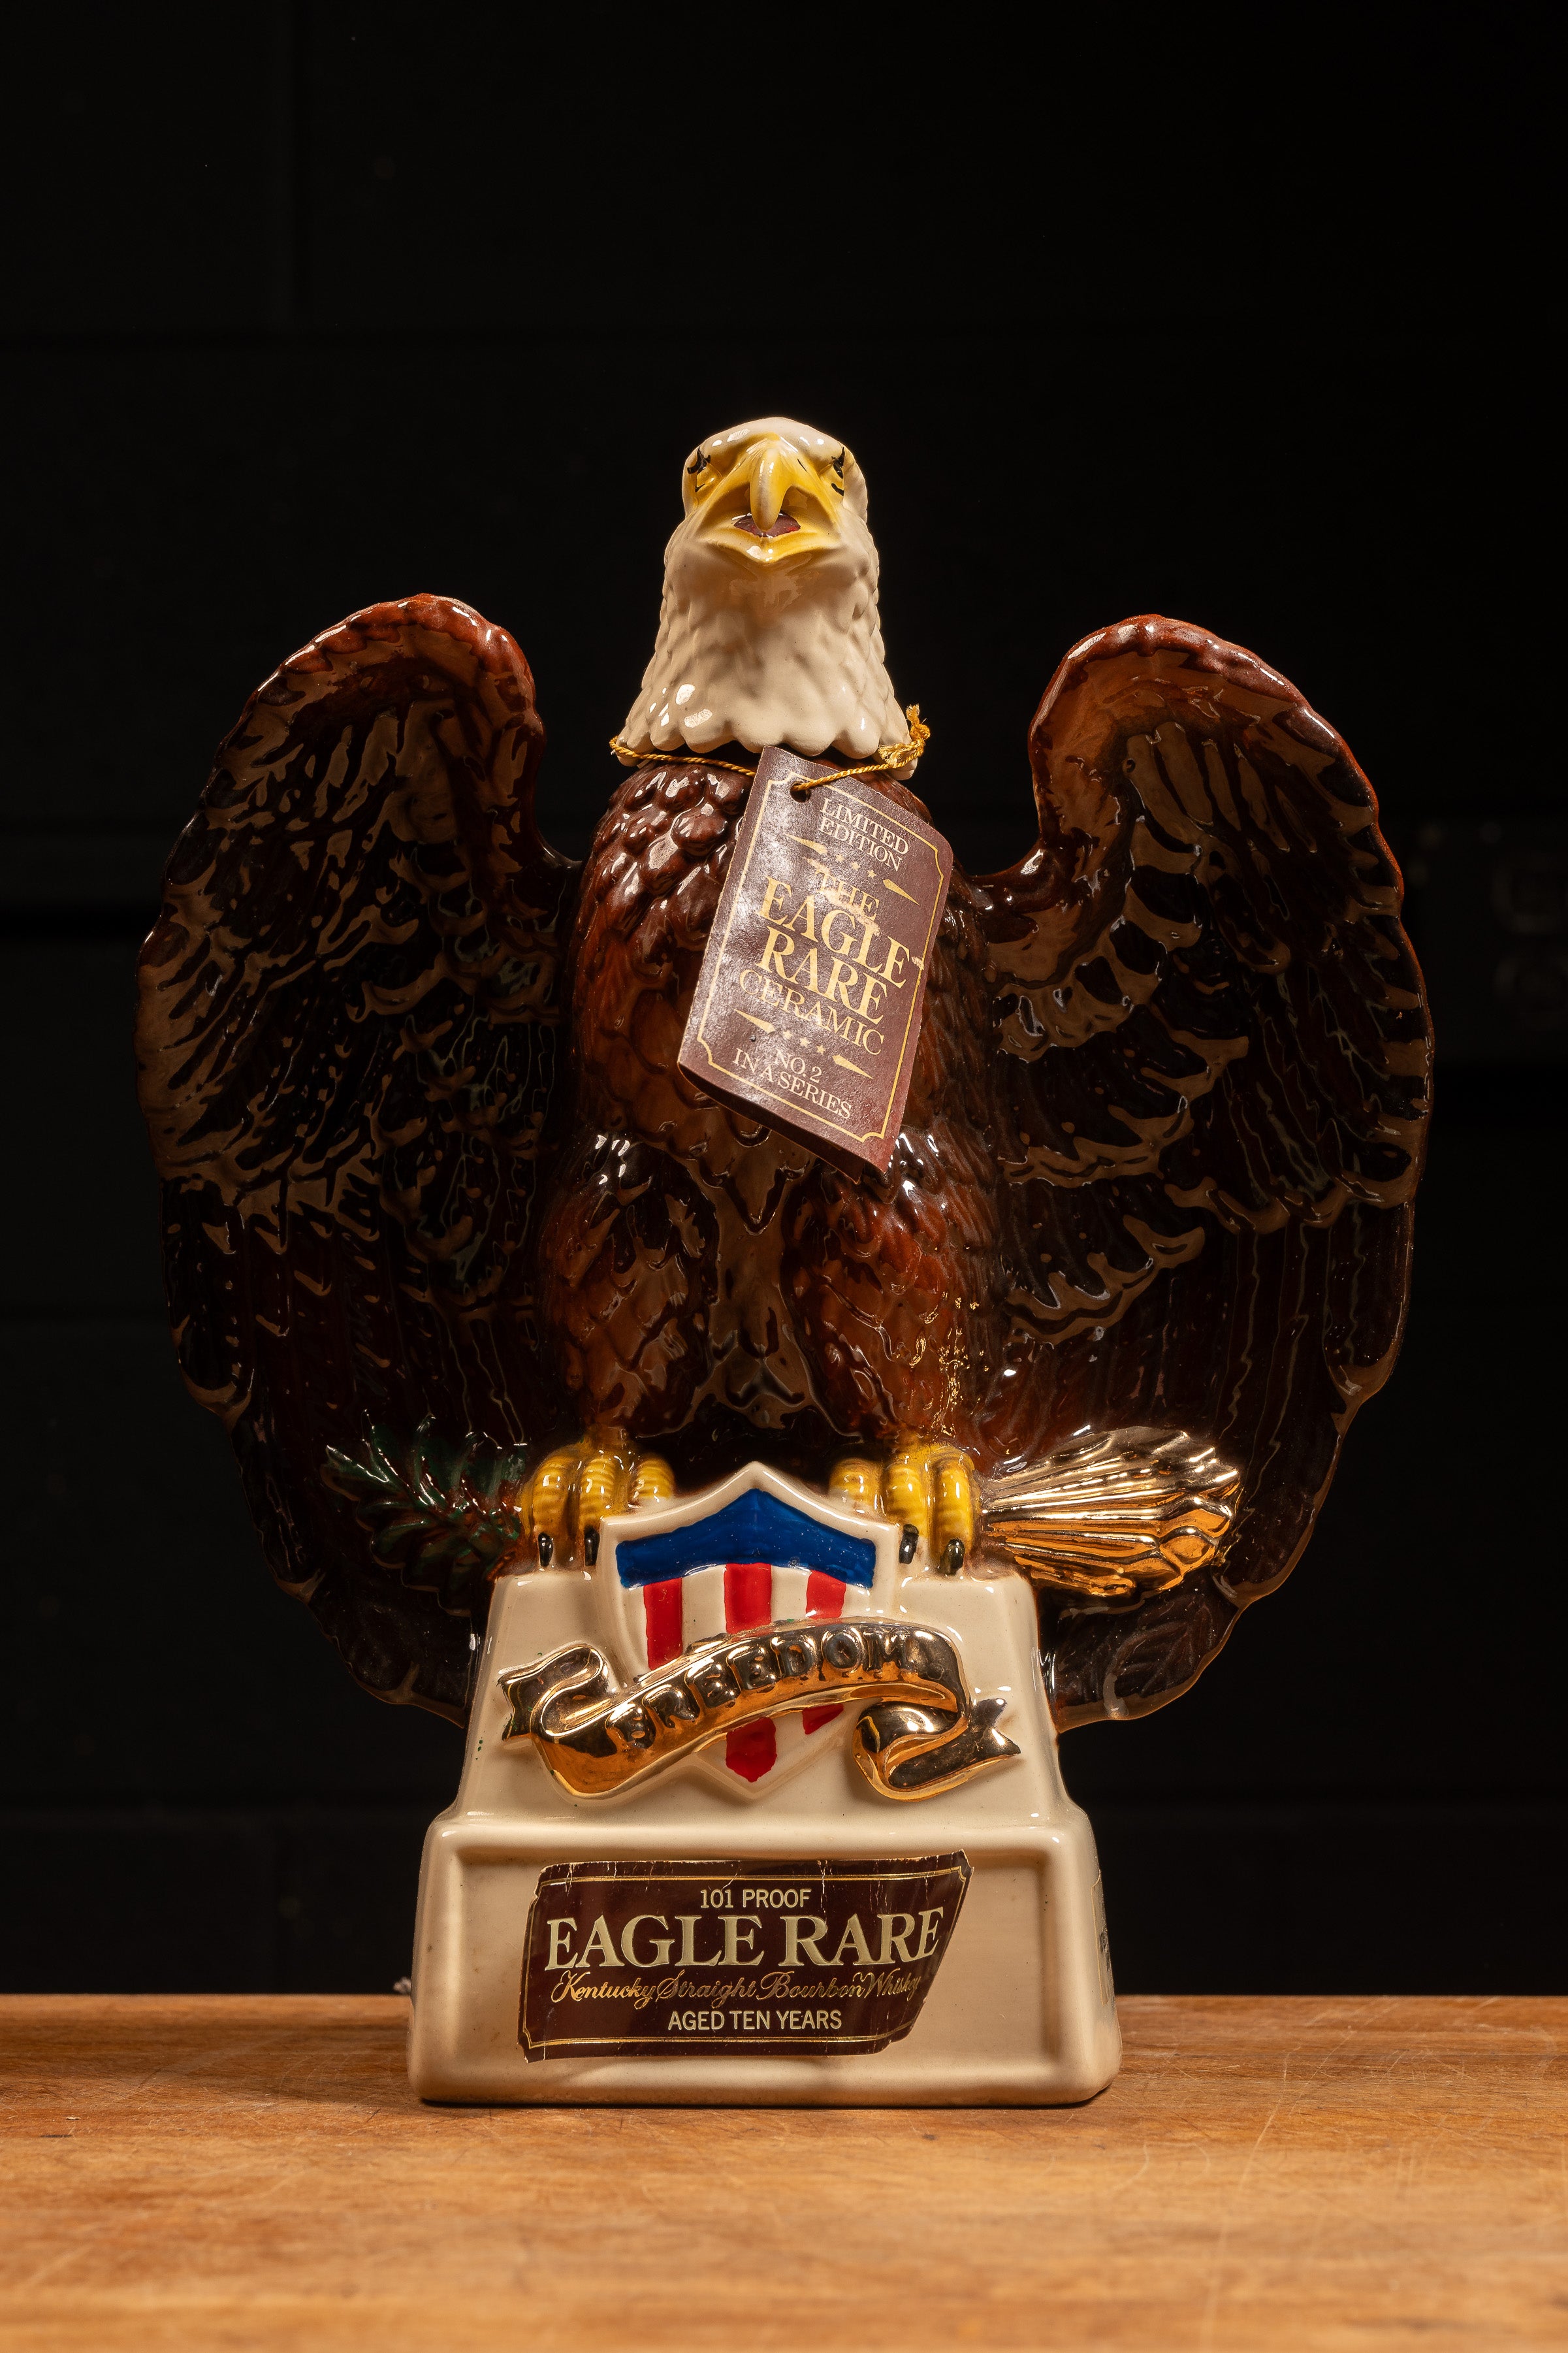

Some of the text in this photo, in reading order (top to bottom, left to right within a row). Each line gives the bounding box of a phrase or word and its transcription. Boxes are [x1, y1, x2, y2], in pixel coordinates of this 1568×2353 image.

[818, 816, 903, 872] EDITION
[820, 798, 909, 855] LIMITED
[814, 868, 880, 922] THE
[756, 876, 910, 989] EAGLE
[755, 926, 888, 1025] RARE
[739, 969, 885, 1056] CERAMIC
[732, 1048, 852, 1120] IN A SERIES
[604, 1629, 916, 1752] FREEDOM
[700, 1889, 812, 1908] 101 PROOF
[545, 1906, 944, 1971] EAGLE RARE
[551, 1970, 656, 2009] Kentucky
[655, 1969, 757, 2009] Straight
[756, 1971, 865, 2000] Bourbon
[668, 2009, 842, 2030] AGED TEN YEARS
